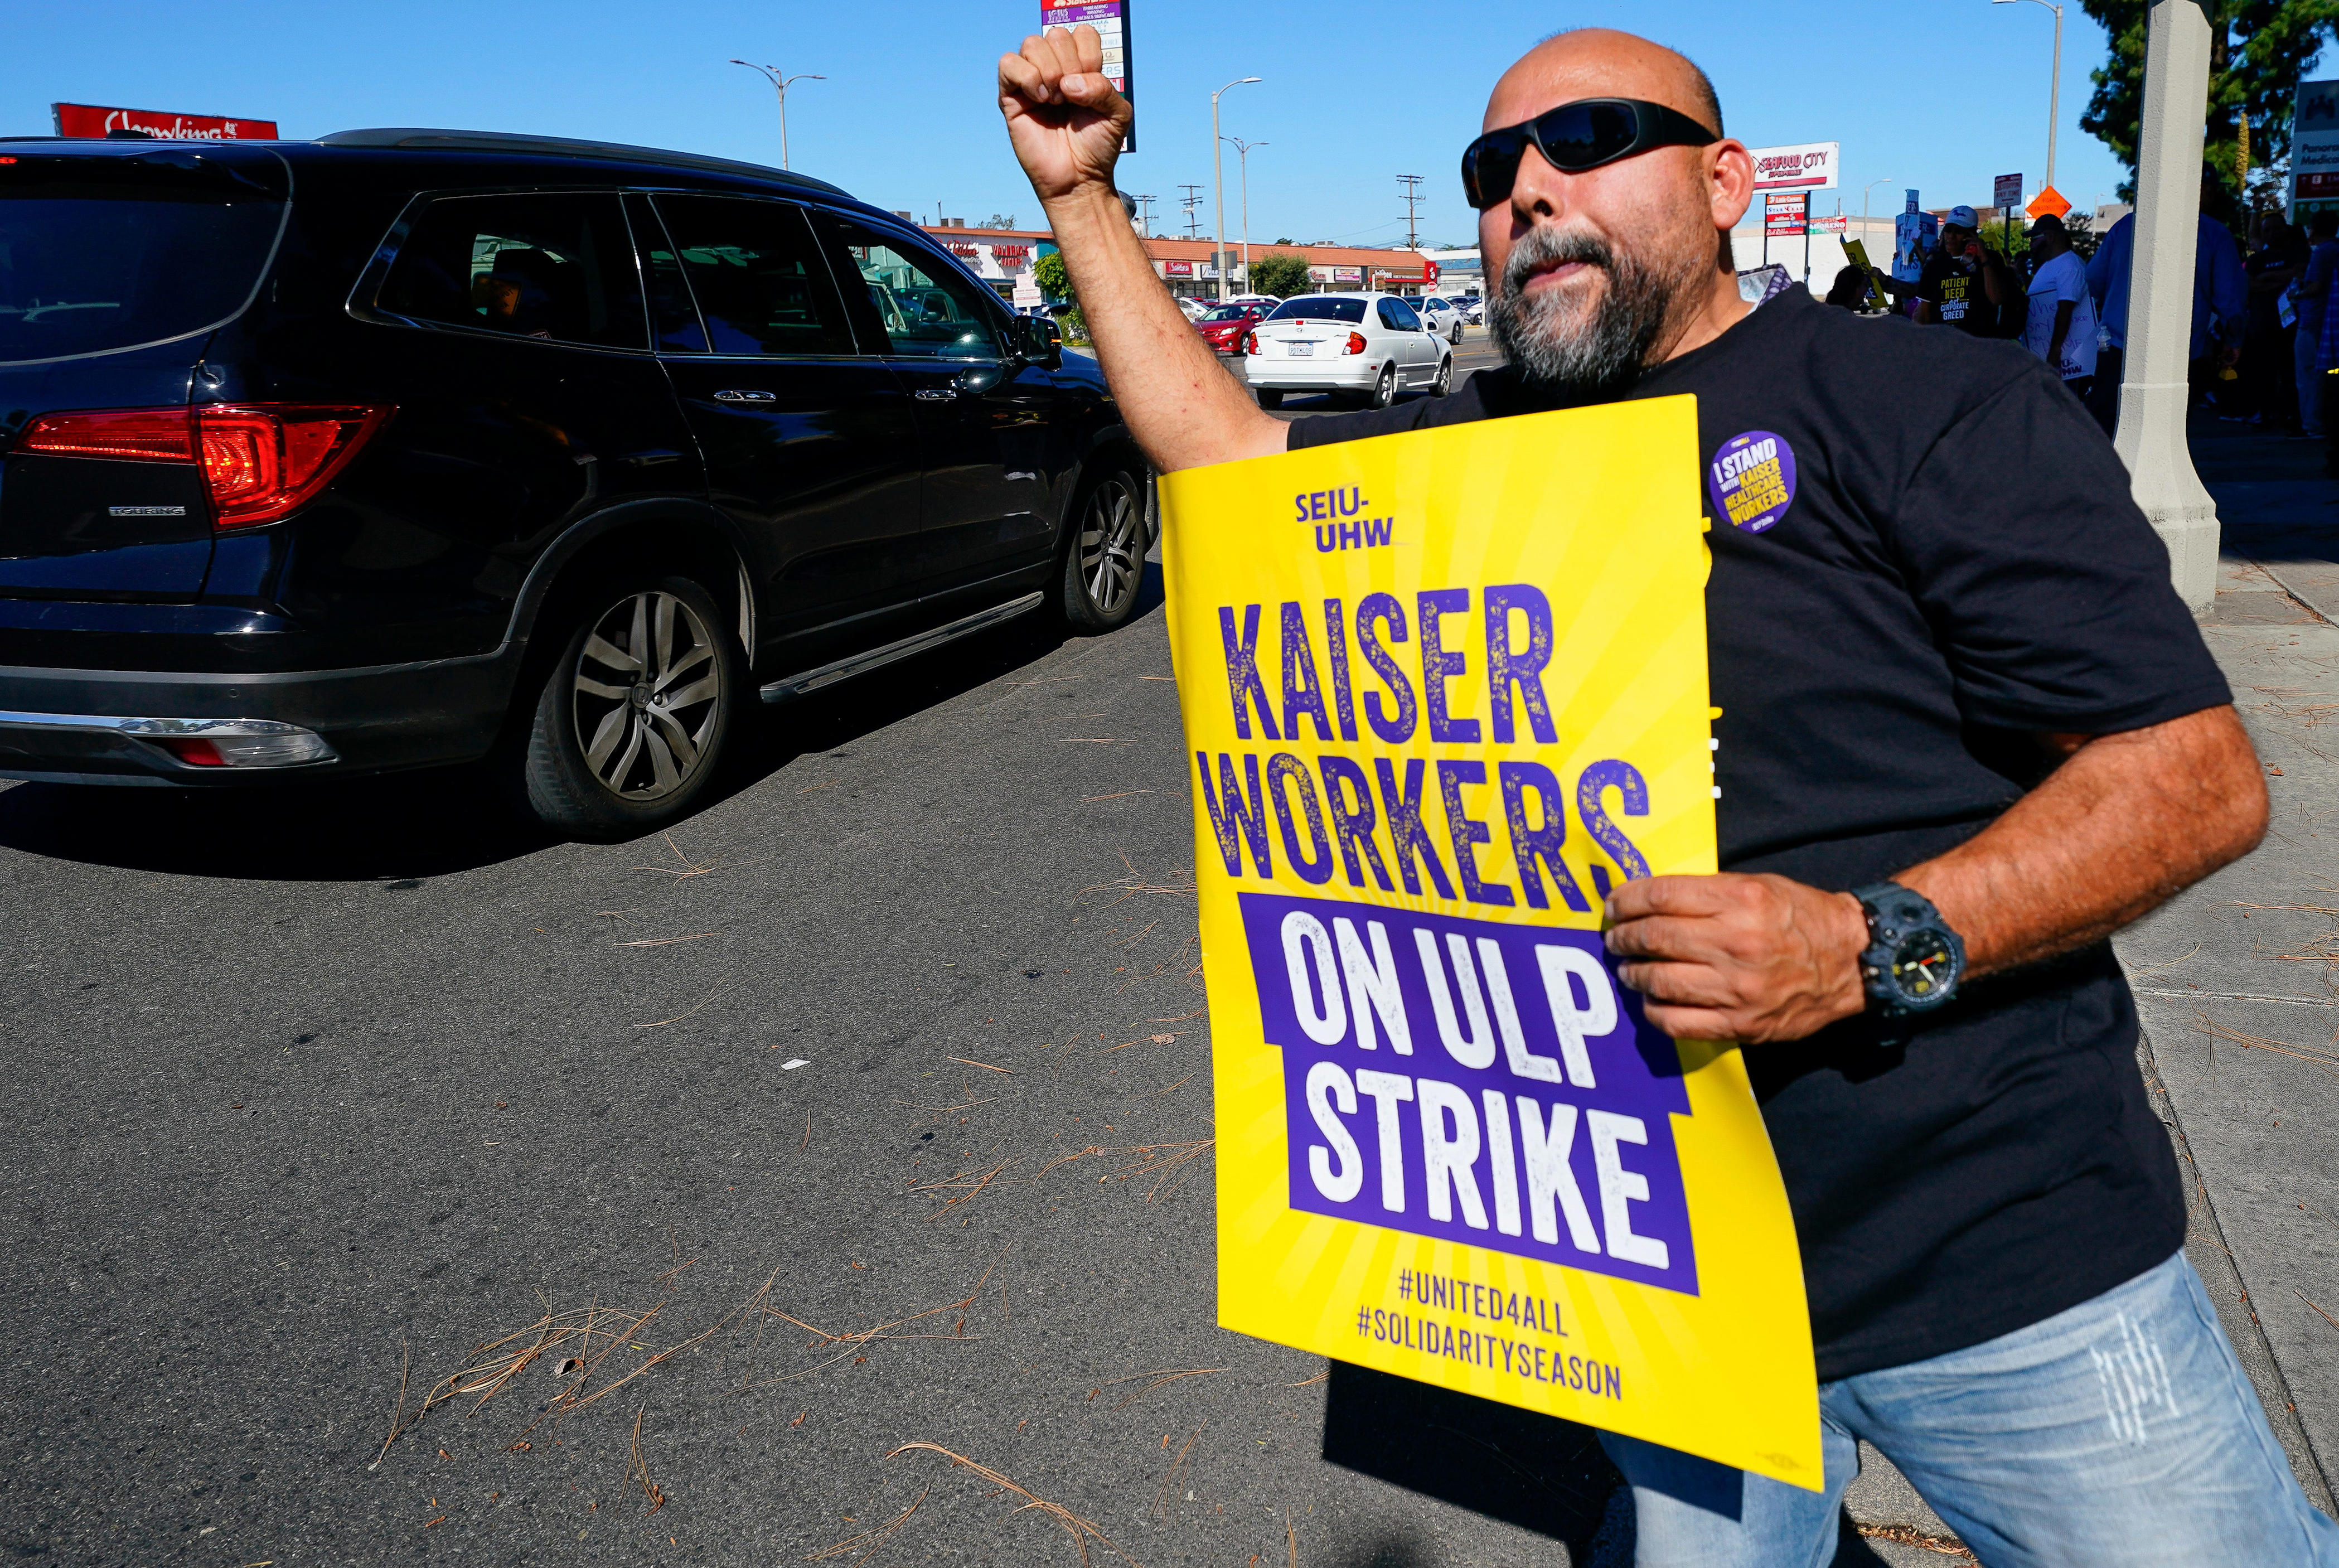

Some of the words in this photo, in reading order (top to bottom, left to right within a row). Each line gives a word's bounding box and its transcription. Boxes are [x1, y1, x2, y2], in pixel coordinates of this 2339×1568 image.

[1759, 154, 1802, 173] SEAFOOD
[1803, 151, 1828, 169] CITY
[1941, 277, 1970, 289] PATIENT
[1945, 287, 1964, 299] NEED
[1943, 310, 1964, 320] GREED
[1713, 462, 1724, 484] I
[1721, 438, 1778, 480] STAND
[1738, 457, 1781, 489] KAISER
[1295, 486, 1369, 522] SEIU-
[1723, 471, 1784, 511] HEALTHCARE
[1728, 485, 1789, 526] WORKERS
[1315, 516, 1393, 553] UHW
[1218, 583, 1558, 744] KAISER
[1196, 751, 1652, 913] WORKERS
[1280, 909, 1414, 1057] ON
[1412, 927, 1619, 1089] ULP
[1305, 1060, 1670, 1270] STRIKE
[1398, 1268, 1568, 1338] #UNITED4ALL
[1357, 1305, 1621, 1401] #SOLIDARITYSEASON
